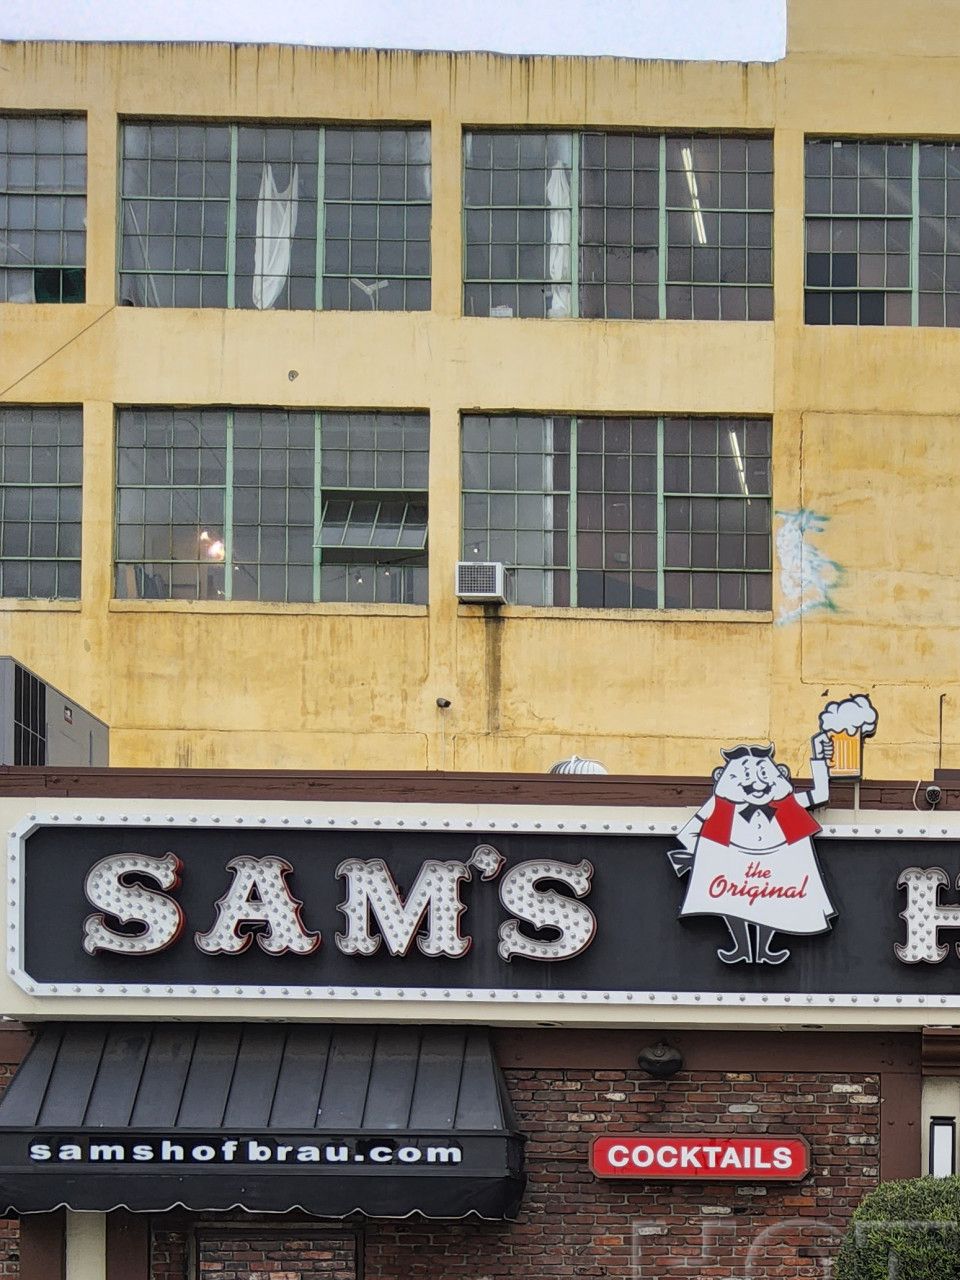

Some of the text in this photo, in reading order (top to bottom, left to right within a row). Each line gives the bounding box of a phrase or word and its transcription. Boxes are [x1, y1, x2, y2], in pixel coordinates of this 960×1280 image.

[745, 861, 772, 878] the
[81, 843, 599, 963] SAM'S
[709, 875, 809, 905] Original
[30, 1139, 463, 1166] samshofbrau.com
[606, 1144, 794, 1171] COCKTAILS
